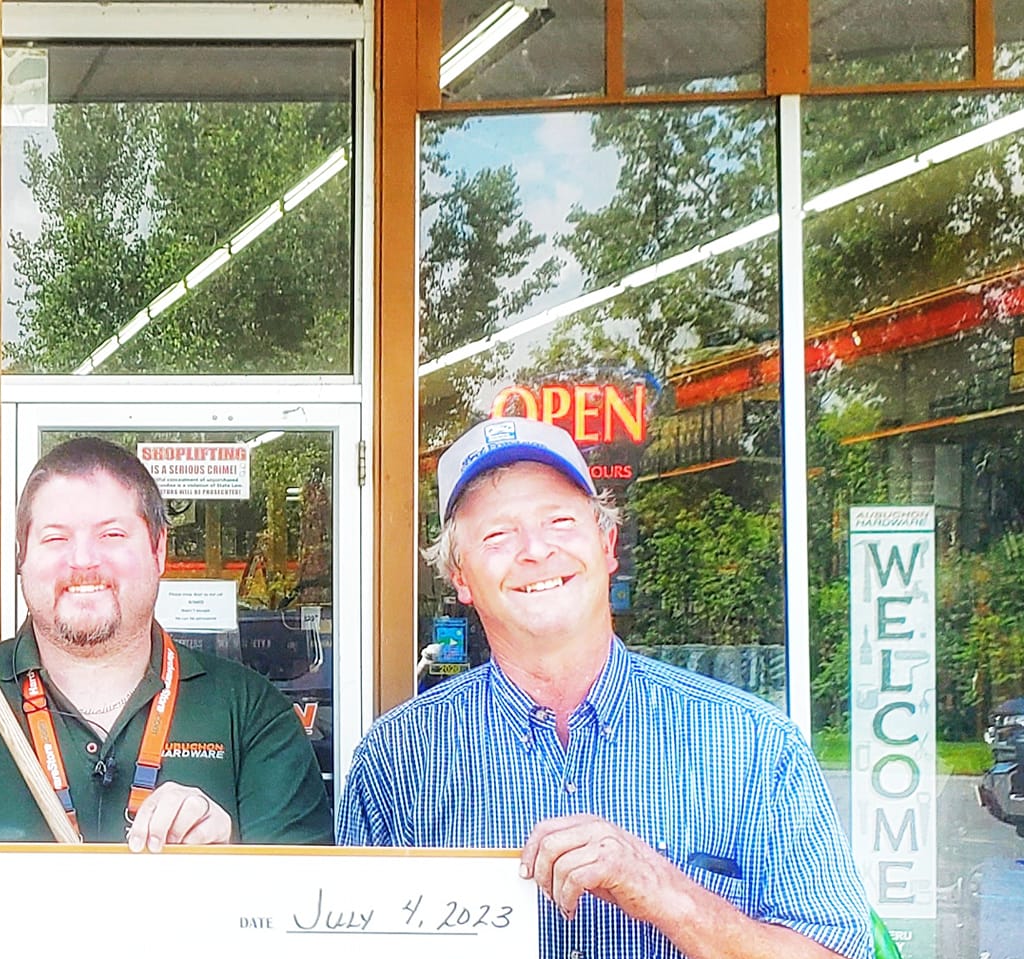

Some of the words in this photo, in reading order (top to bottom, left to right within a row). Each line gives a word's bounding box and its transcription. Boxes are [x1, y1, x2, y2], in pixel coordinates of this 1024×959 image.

[491, 384, 647, 443] OPEN
[141, 447, 247, 460] SHOPLIFTING
[150, 465, 160, 475] IS
[161, 465, 167, 475] A
[169, 465, 205, 475] SERIOUS
[207, 465, 238, 475] CRIME!
[589, 464, 633, 480] OURS
[868, 542, 922, 904] WELCOME
[240, 917, 273, 929] DATE
[437, 901, 514, 931] 2023
